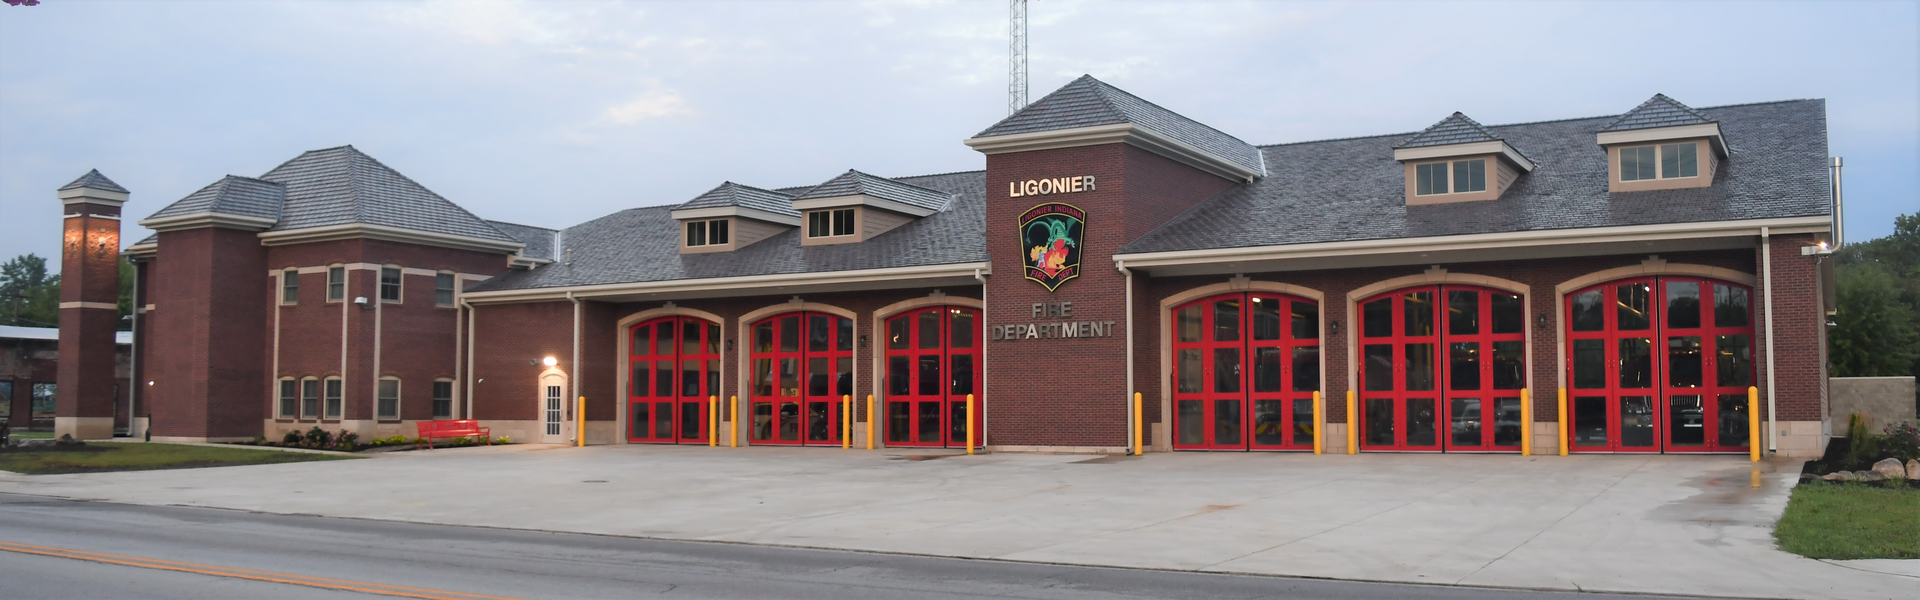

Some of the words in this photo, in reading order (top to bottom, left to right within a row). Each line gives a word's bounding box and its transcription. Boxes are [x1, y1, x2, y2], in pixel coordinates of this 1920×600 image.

[1009, 175, 1096, 198] LIGONIER
[1021, 205, 1052, 224] LIGONIER
[1054, 205, 1083, 220] INDIANA
[1030, 269, 1047, 281] FIRE
[1058, 267, 1074, 281] DEPT
[1031, 301, 1072, 318] FIRE
[991, 321, 1116, 341] DEPARTMENT
